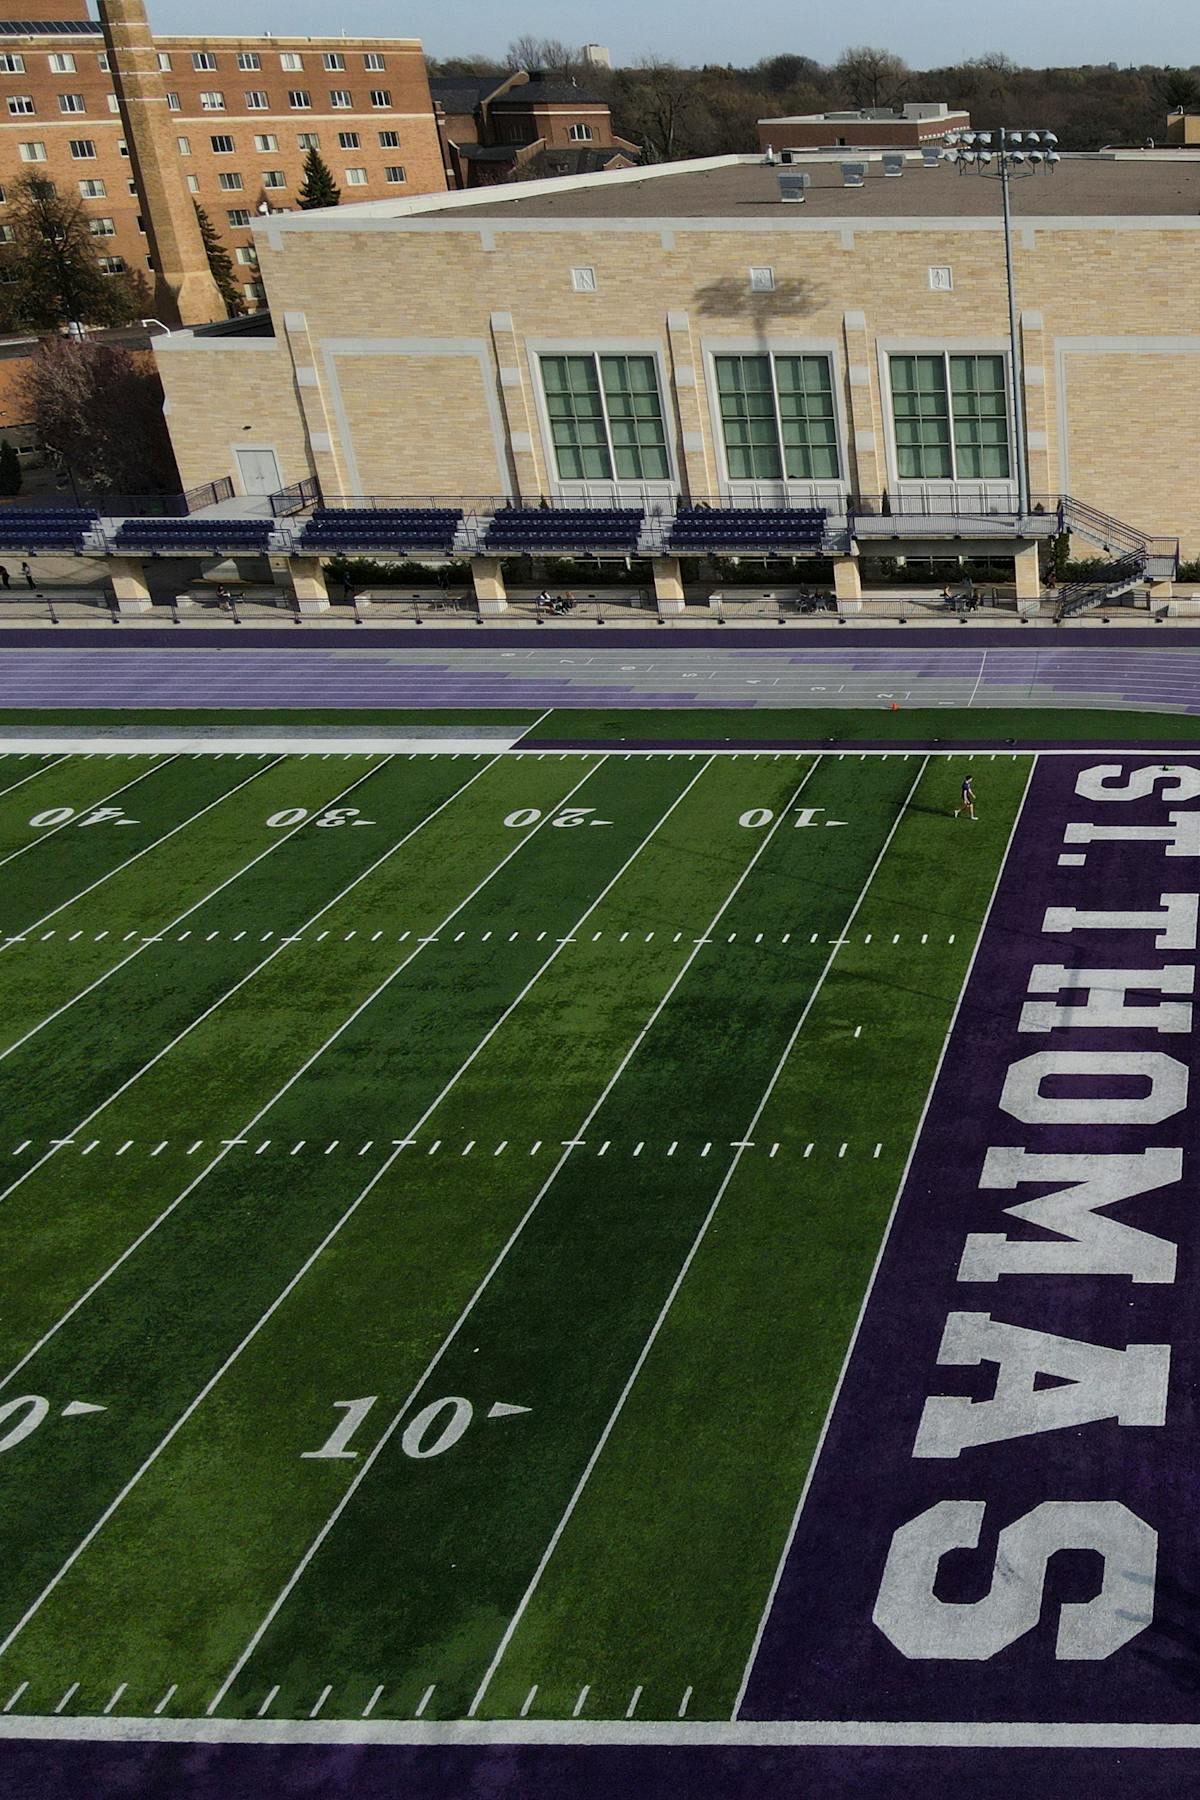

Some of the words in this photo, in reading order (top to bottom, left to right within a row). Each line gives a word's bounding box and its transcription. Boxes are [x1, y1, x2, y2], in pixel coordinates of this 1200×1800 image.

[28, 807, 126, 827] 40
[265, 807, 361, 828] 30
[503, 807, 597, 828] 20
[738, 808, 826, 828] 10
[871, 892, 1200, 1661] THOMAS
[300, 1396, 474, 1459] 10
